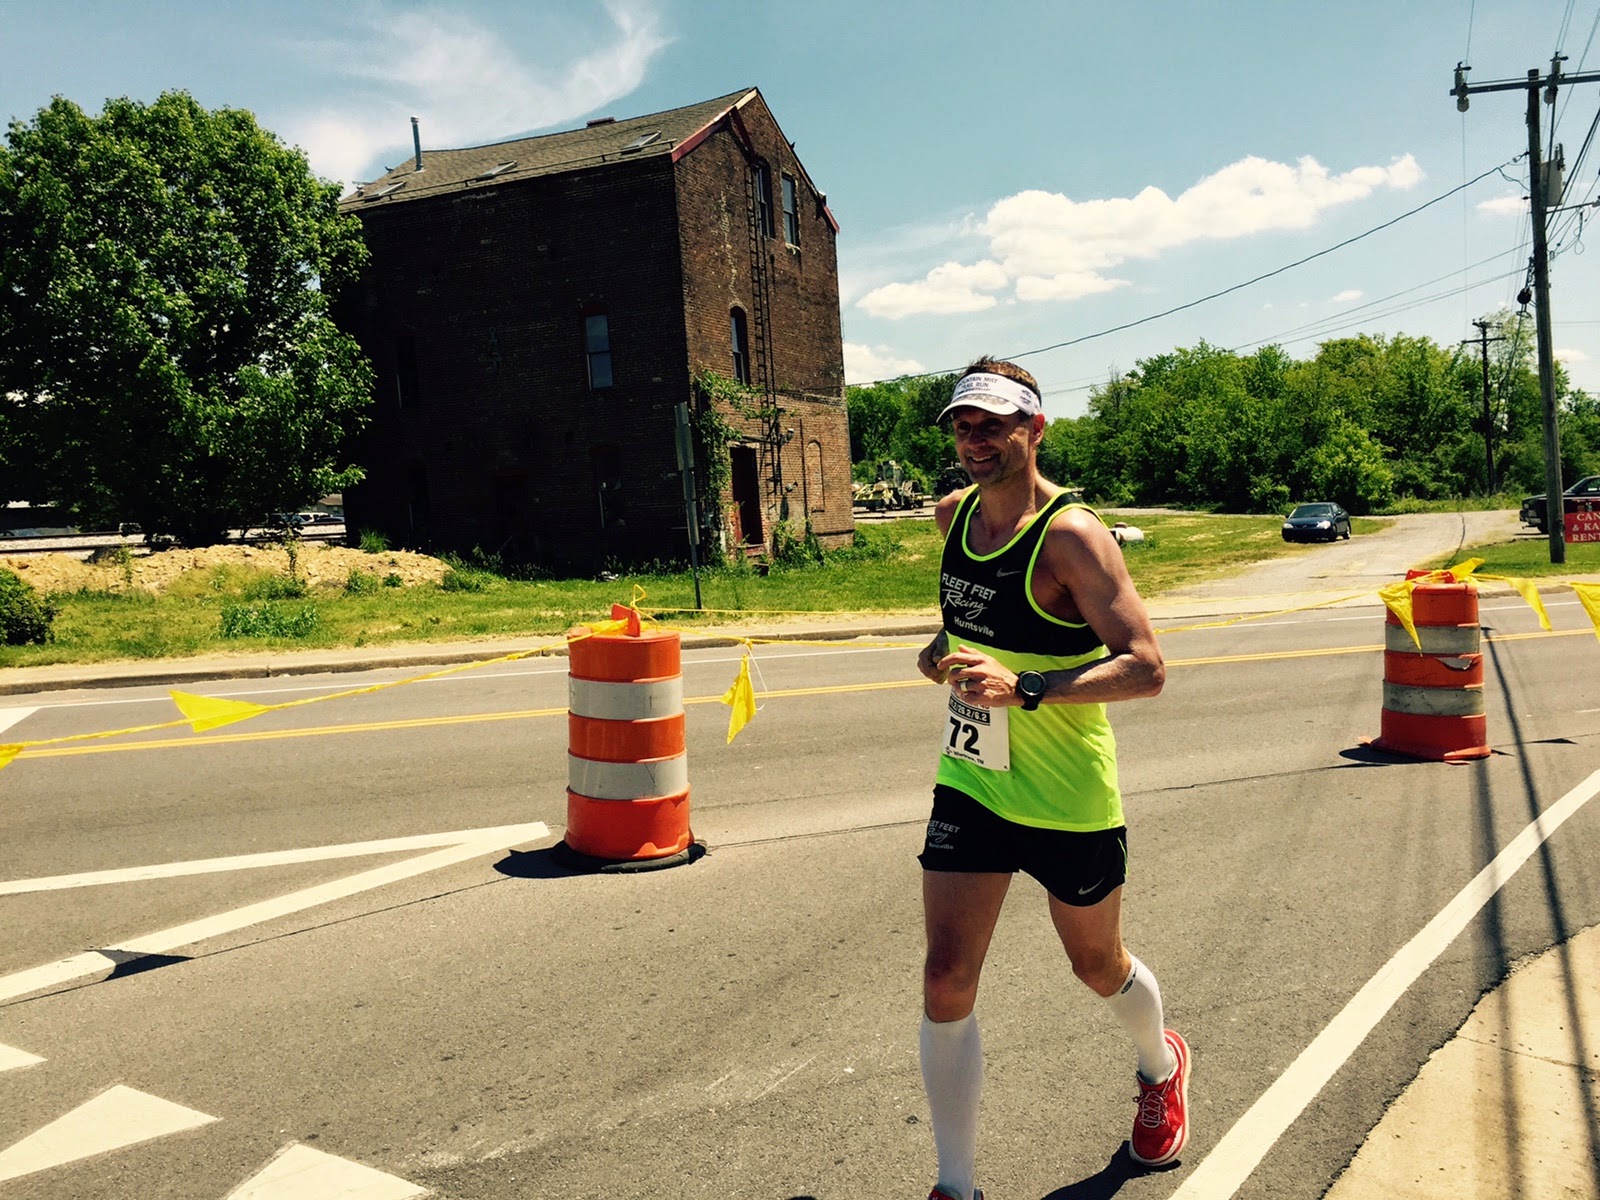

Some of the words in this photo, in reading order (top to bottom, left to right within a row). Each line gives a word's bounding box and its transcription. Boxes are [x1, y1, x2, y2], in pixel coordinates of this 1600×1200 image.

[942, 573, 971, 592] FLEET
[970, 584, 997, 601] FEET
[941, 589, 988, 620] Racing
[950, 716, 980, 756] 72
[939, 822, 960, 833] FEET
